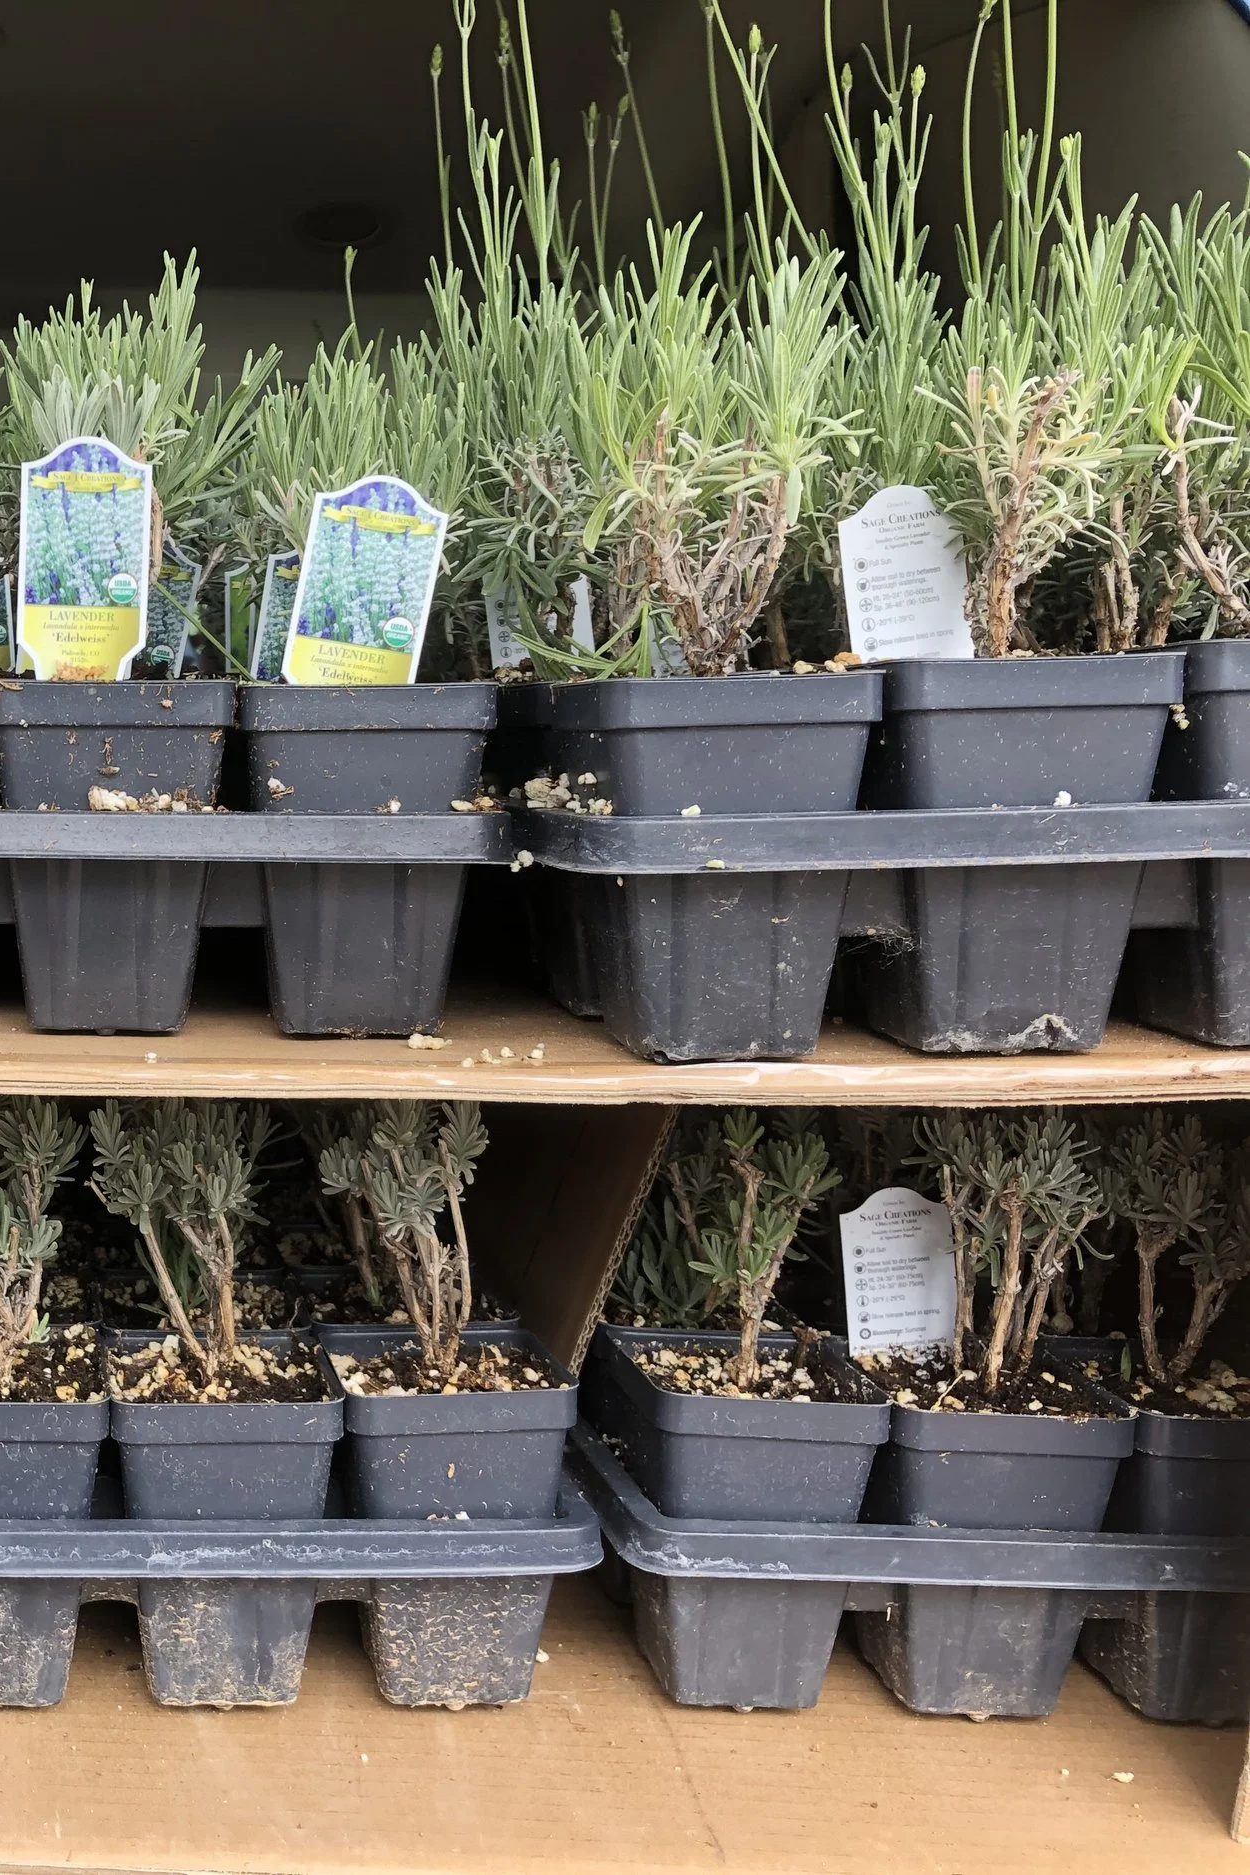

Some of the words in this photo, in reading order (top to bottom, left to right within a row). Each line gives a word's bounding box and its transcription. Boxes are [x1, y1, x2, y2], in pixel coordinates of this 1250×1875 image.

[80, 473, 122, 482] CREATIONS
[374, 512, 416, 526] CREATIONS
[861, 517, 887, 529] SAGE
[888, 509, 941, 525] CREATIONS
[878, 525, 905, 534] ORGANIC
[907, 521, 925, 530] FARM
[869, 559, 879, 567] Full
[880, 558, 892, 566] Sun
[906, 570, 915, 579] dry
[916, 566, 941, 576] between
[114, 579, 131, 587] USDA
[49, 610, 115, 622] LAVENDER
[42, 622, 78, 631] Lavandula
[391, 622, 408, 632] USDA
[387, 631, 411, 641] ORGANIC
[319, 644, 386, 665] LAVENDER
[859, 1212, 881, 1222] SAGE
[884, 1208, 932, 1220] CREATIONS
